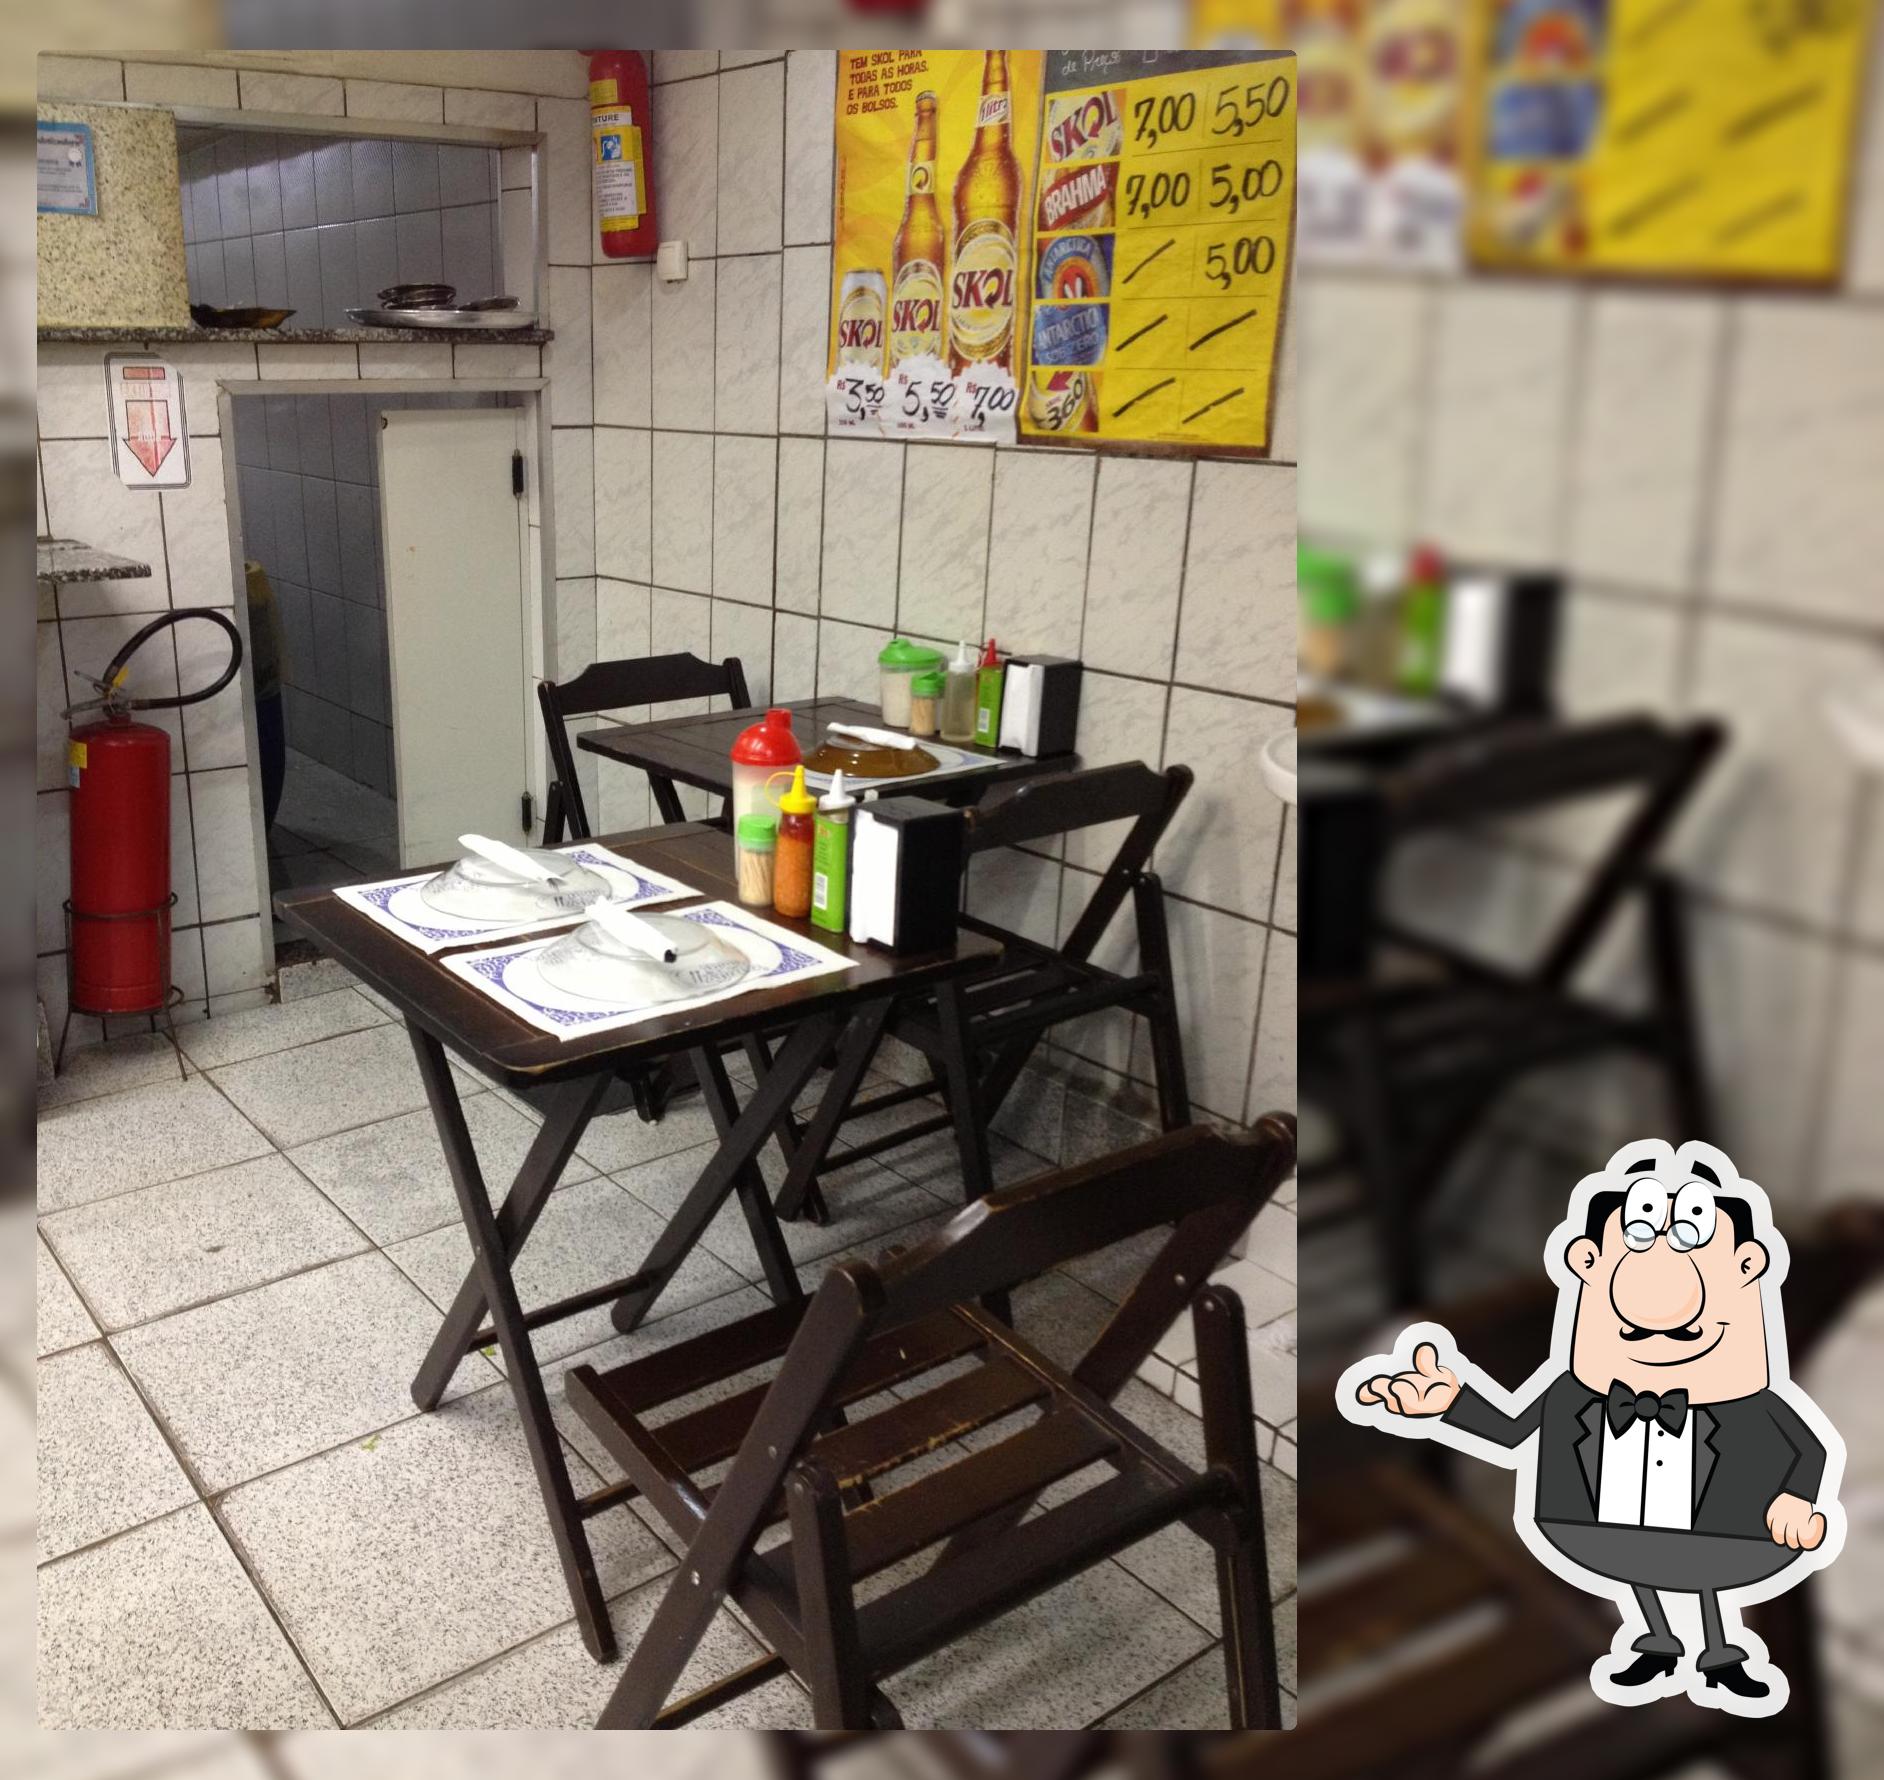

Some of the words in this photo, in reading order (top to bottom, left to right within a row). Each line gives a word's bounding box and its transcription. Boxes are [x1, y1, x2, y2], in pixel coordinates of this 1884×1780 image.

[850, 56, 867, 70] TEM
[871, 51, 894, 67] SKOL
[898, 50, 922, 61] PARA
[850, 69, 878, 85] TODAS
[881, 66, 893, 80] AS
[897, 60, 929, 78] HORAS.
[846, 103, 858, 115] OS
[861, 97, 898, 113] BOLSOS.
[848, 90, 855, 101] E
[857, 84, 880, 99] PARA
[883, 79, 912, 94] TODOS
[1050, 90, 1117, 160] SKOL
[1134, 92, 1196, 149] 7,00
[1212, 76, 1289, 137] 5,50
[1045, 165, 1107, 227] BRAHMA
[1125, 172, 1190, 219] 7,00
[1209, 159, 1283, 214] 5,00
[1205, 236, 1275, 290] 5,00
[952, 267, 1013, 309] SKOL
[839, 319, 883, 349] SKOL
[891, 299, 940, 333] SKOL
[846, 378, 886, 420] 3,50
[902, 381, 956, 422] 5,50
[971, 386, 1016, 427] 7,00
[1046, 379, 1083, 430] 360
